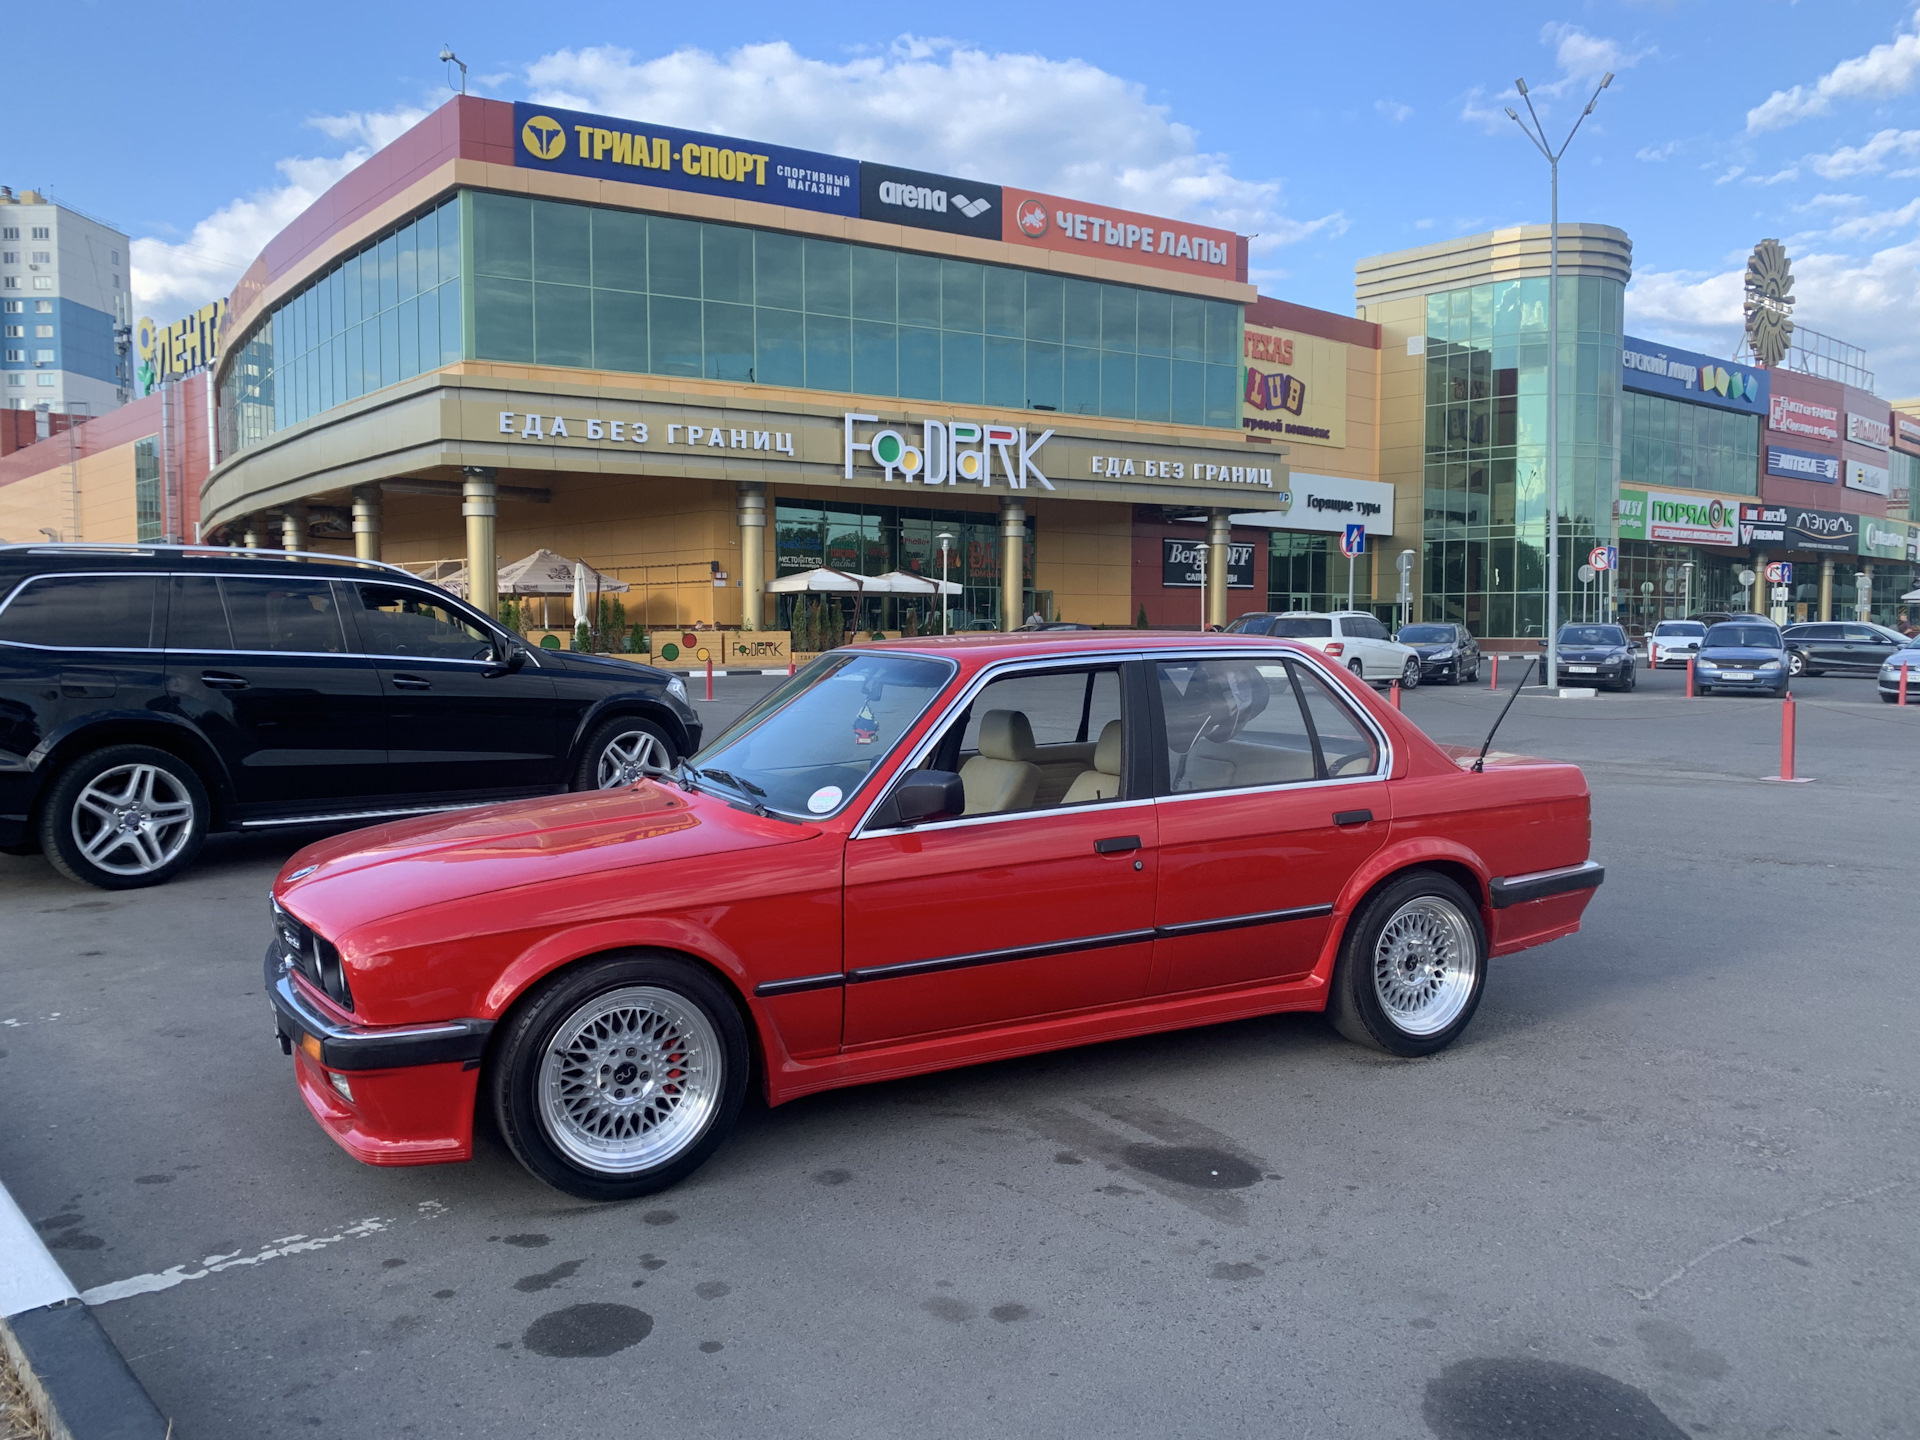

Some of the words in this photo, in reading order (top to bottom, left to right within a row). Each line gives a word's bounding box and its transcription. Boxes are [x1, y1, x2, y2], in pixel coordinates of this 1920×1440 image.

[776, 164, 851, 188] СПОРТИВНЫЙ
[787, 179, 842, 197] МАГАЗИН
[879, 180, 947, 213] arena
[1056, 210, 1154, 253] ЧЕТЫРЕ
[1157, 231, 1227, 266] ЛАПЫ
[1244, 330, 1293, 366] TEXAS
[1623, 349, 1668, 377] етский
[1667, 361, 1698, 389] мир
[500, 411, 569, 440] ЕДА
[587, 418, 649, 443] БЕЗ
[668, 423, 795, 456] ГРАНИЦ
[1092, 456, 1136, 478] ЕДА
[1145, 460, 1185, 479] БЕЗ
[1193, 463, 1274, 488] ГРАНИЦ
[1779, 454, 1818, 474] АПТЕКА
[1307, 494, 1354, 512] Горящие
[1356, 502, 1381, 516] туры
[1652, 500, 1735, 529] ПОРЯДОК
